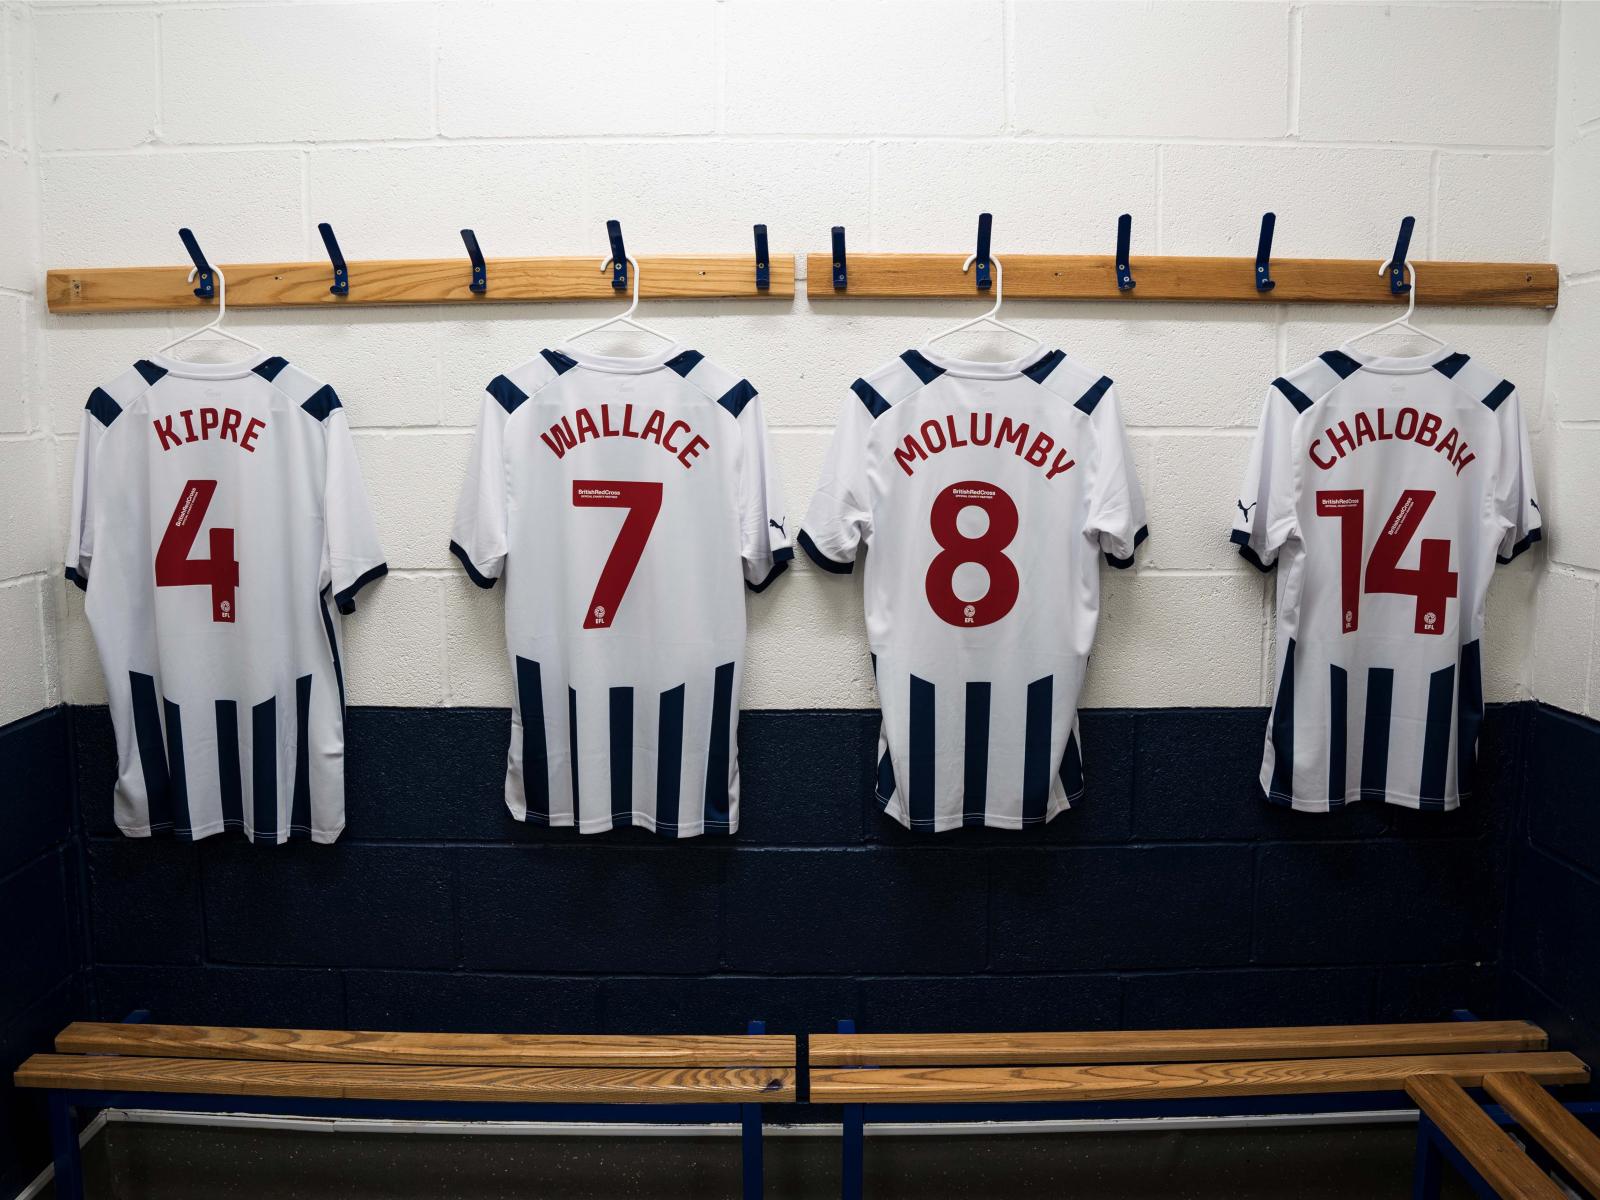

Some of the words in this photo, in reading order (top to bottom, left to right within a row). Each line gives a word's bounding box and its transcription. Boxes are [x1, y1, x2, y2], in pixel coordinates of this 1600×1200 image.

[153, 408, 266, 452] KIPRE
[540, 403, 710, 468] WALLACE
[894, 412, 1075, 480] MOLUMBY
[1309, 407, 1476, 477] CHALOBAH
[155, 480, 239, 622] 4
[572, 480, 663, 629] 7
[925, 480, 1019, 627] 8
[1316, 489, 1458, 635] 14
